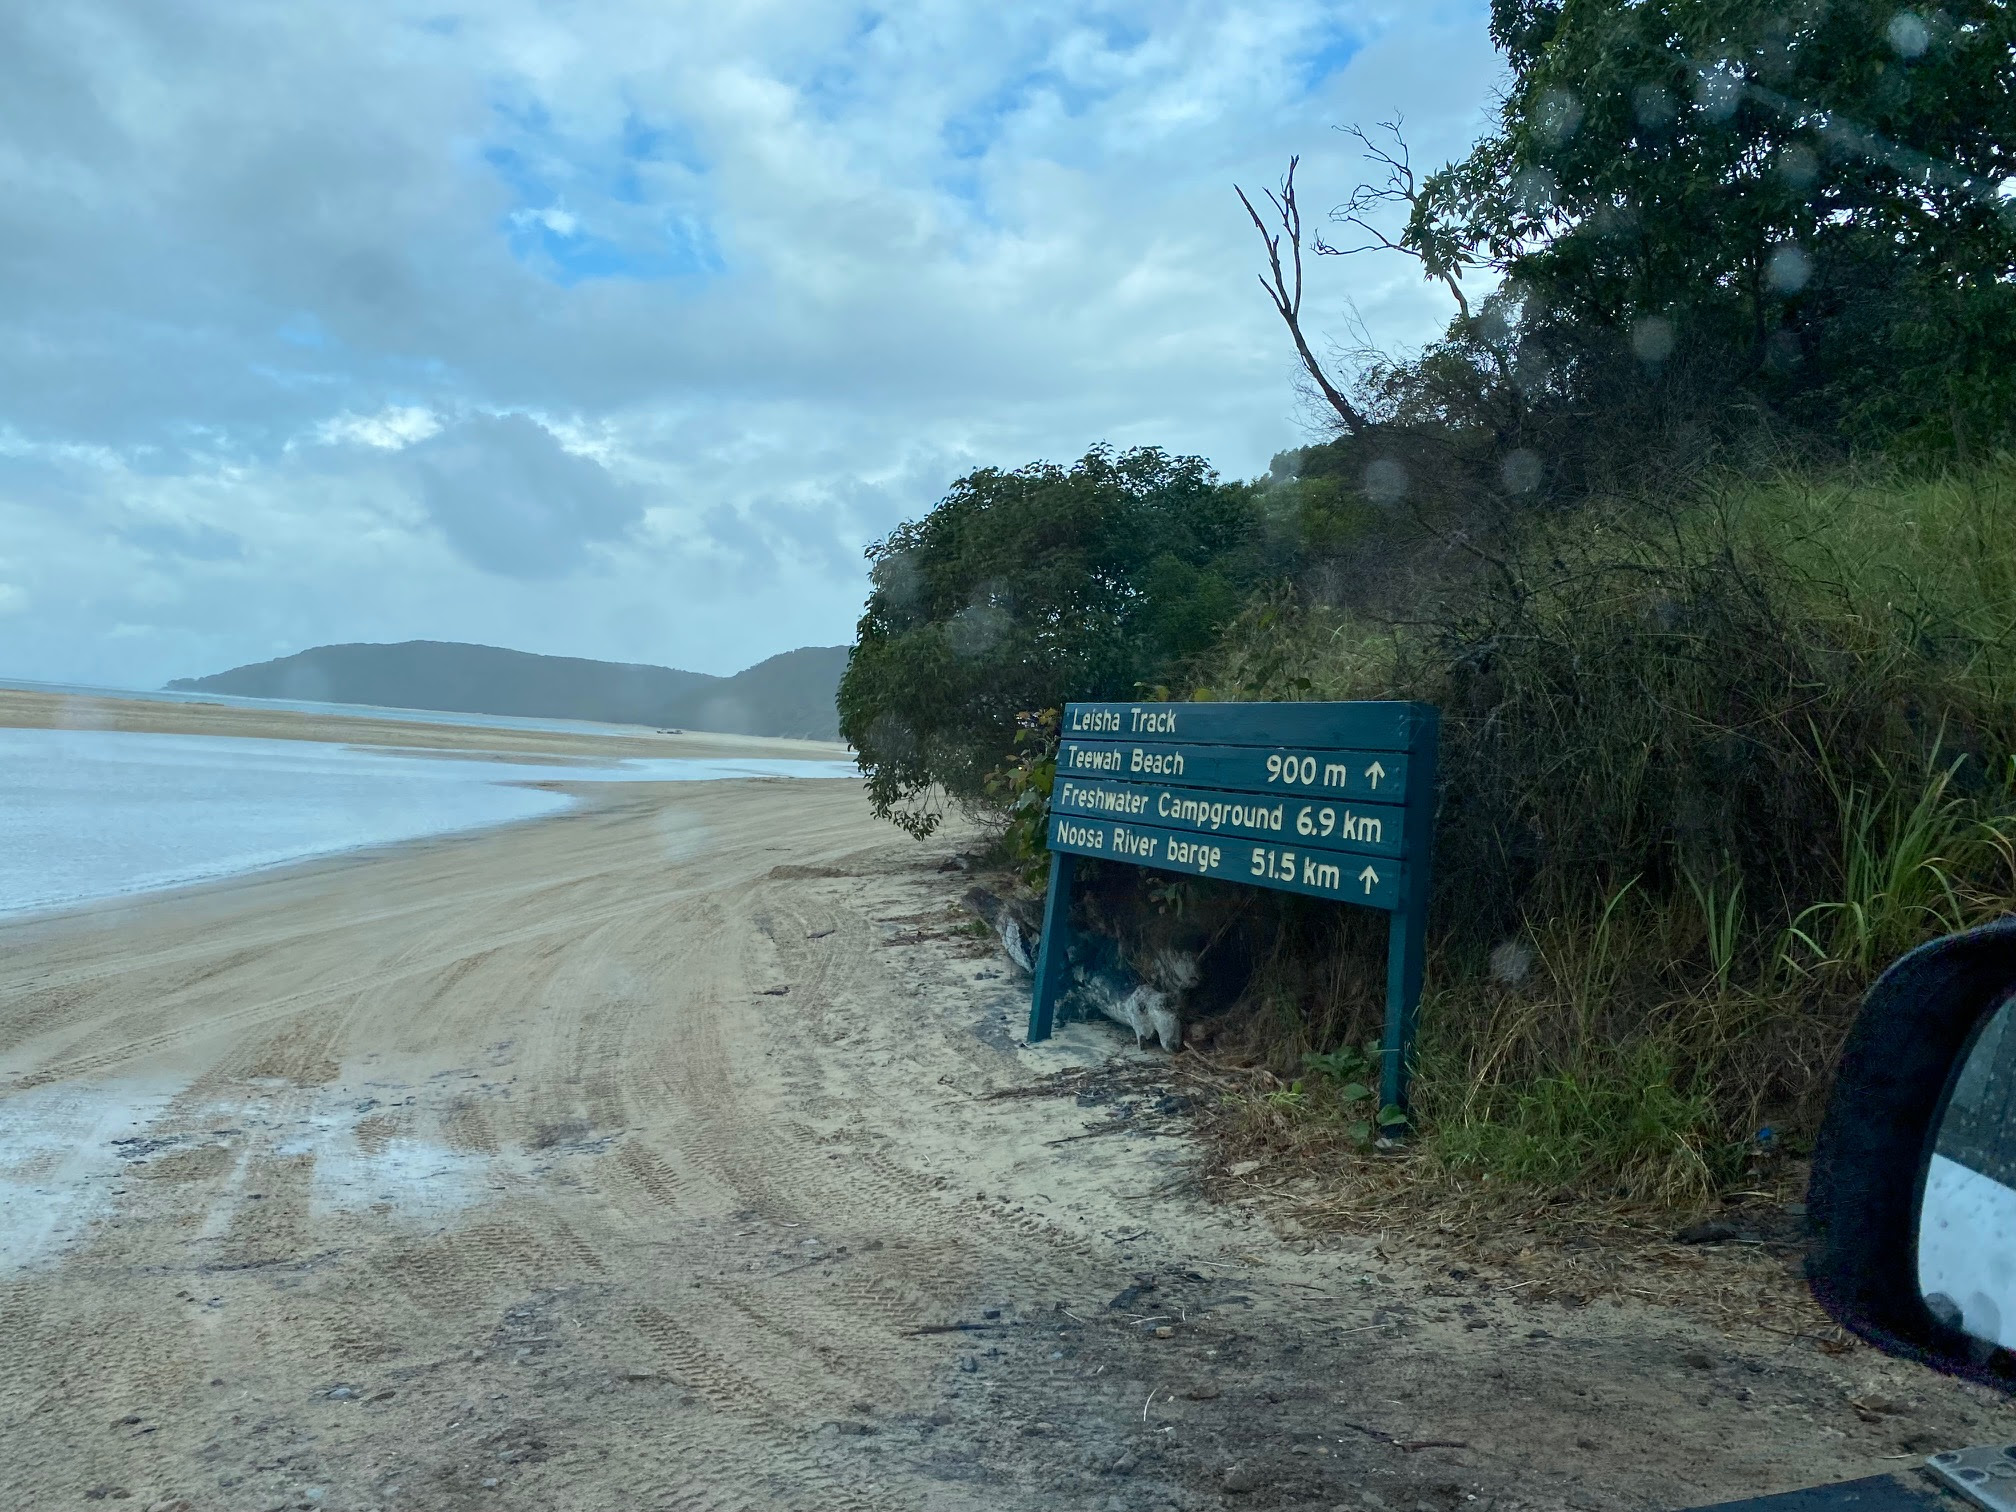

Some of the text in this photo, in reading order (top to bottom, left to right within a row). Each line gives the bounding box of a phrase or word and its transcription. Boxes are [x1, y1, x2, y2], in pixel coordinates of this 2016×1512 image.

[1072, 707, 1177, 733] Leisha Track
[1068, 745, 1347, 788] Teewah Beach 900 m
[1061, 783, 1382, 843] Freshwater Campground 6.9 km
[1057, 819, 1340, 890] Noosa River barge 51.5 km
